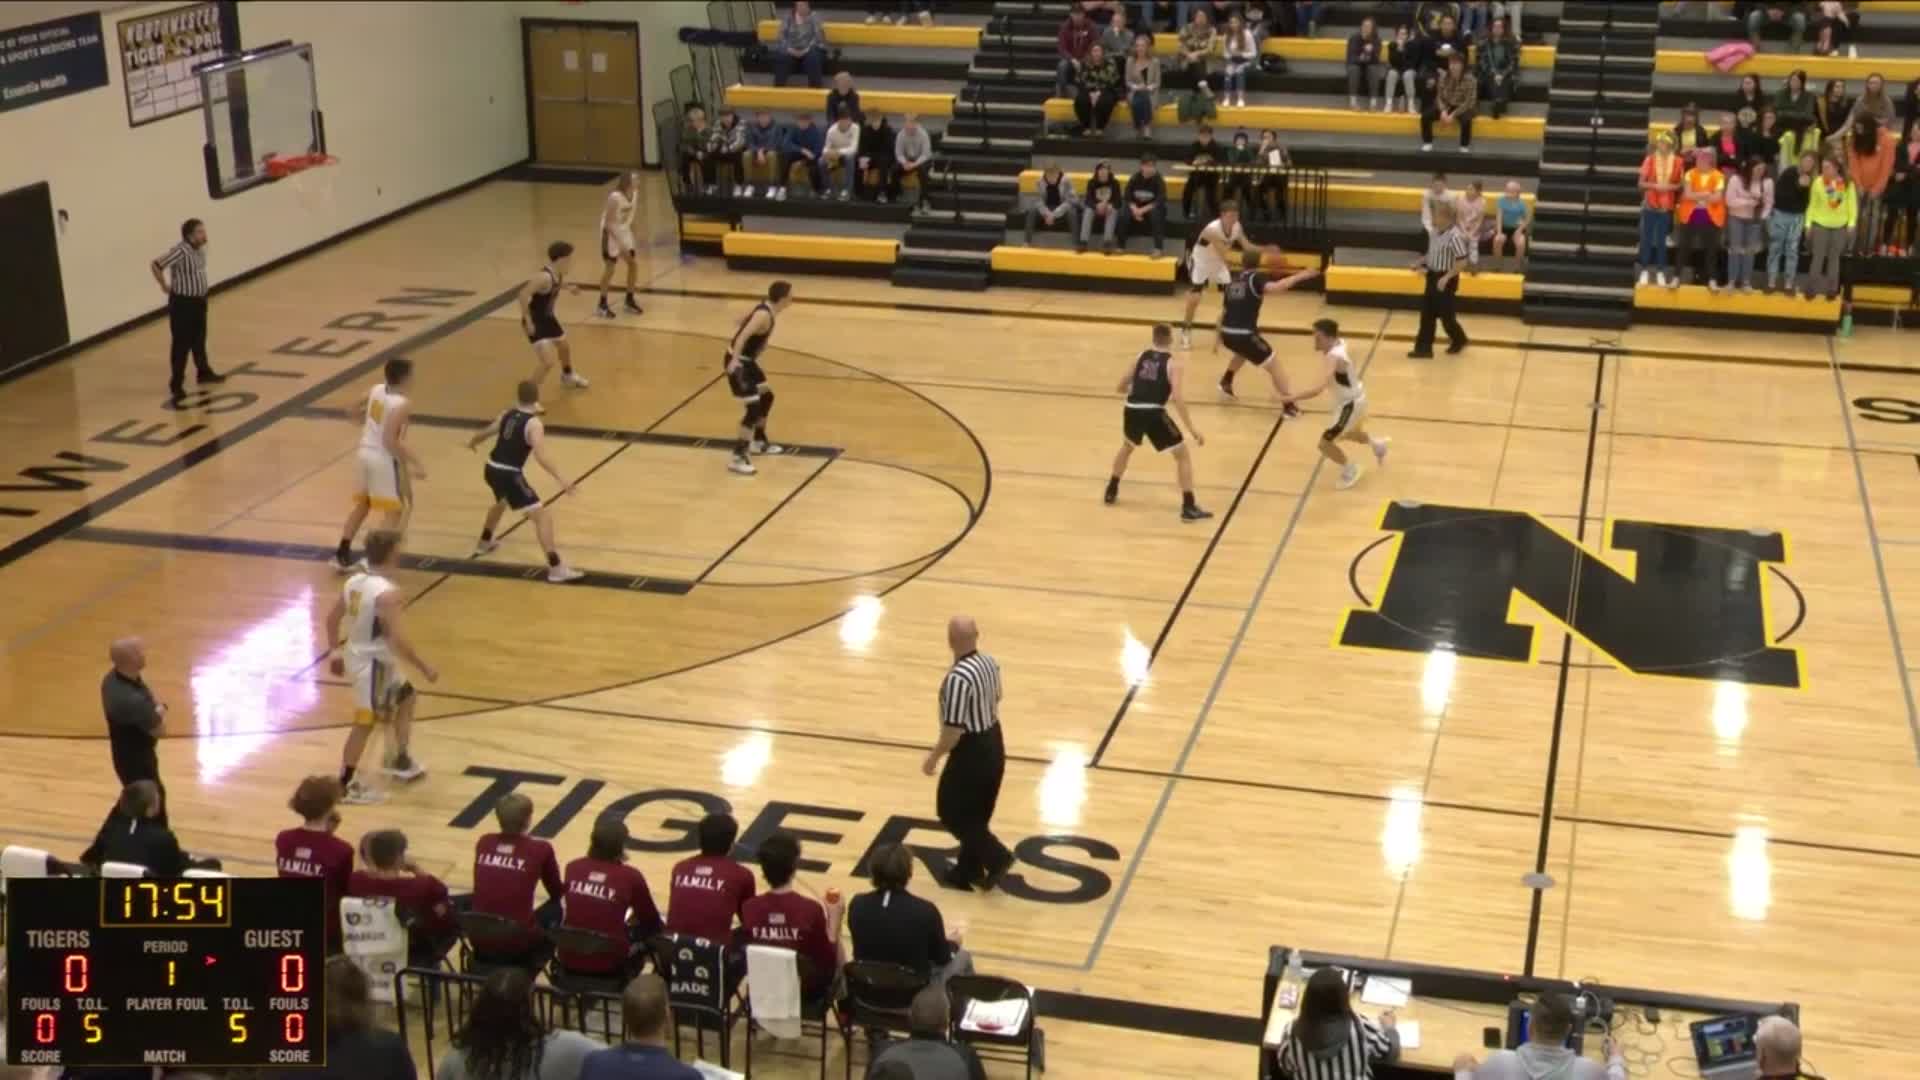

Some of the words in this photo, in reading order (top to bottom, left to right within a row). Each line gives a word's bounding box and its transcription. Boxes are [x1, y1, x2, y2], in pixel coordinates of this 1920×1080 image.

[7, 48, 39, 63] SPORTS
[40, 39, 76, 54] MEDICINE
[77, 33, 98, 47] TEAM
[125, 45, 166, 67] TIGER
[3, 81, 39, 99] Essentia
[40, 74, 68, 88] Health
[1336, 500, 1808, 689] N
[449, 765, 1120, 906] TIGERS
[671, 982, 709, 996] RADE
